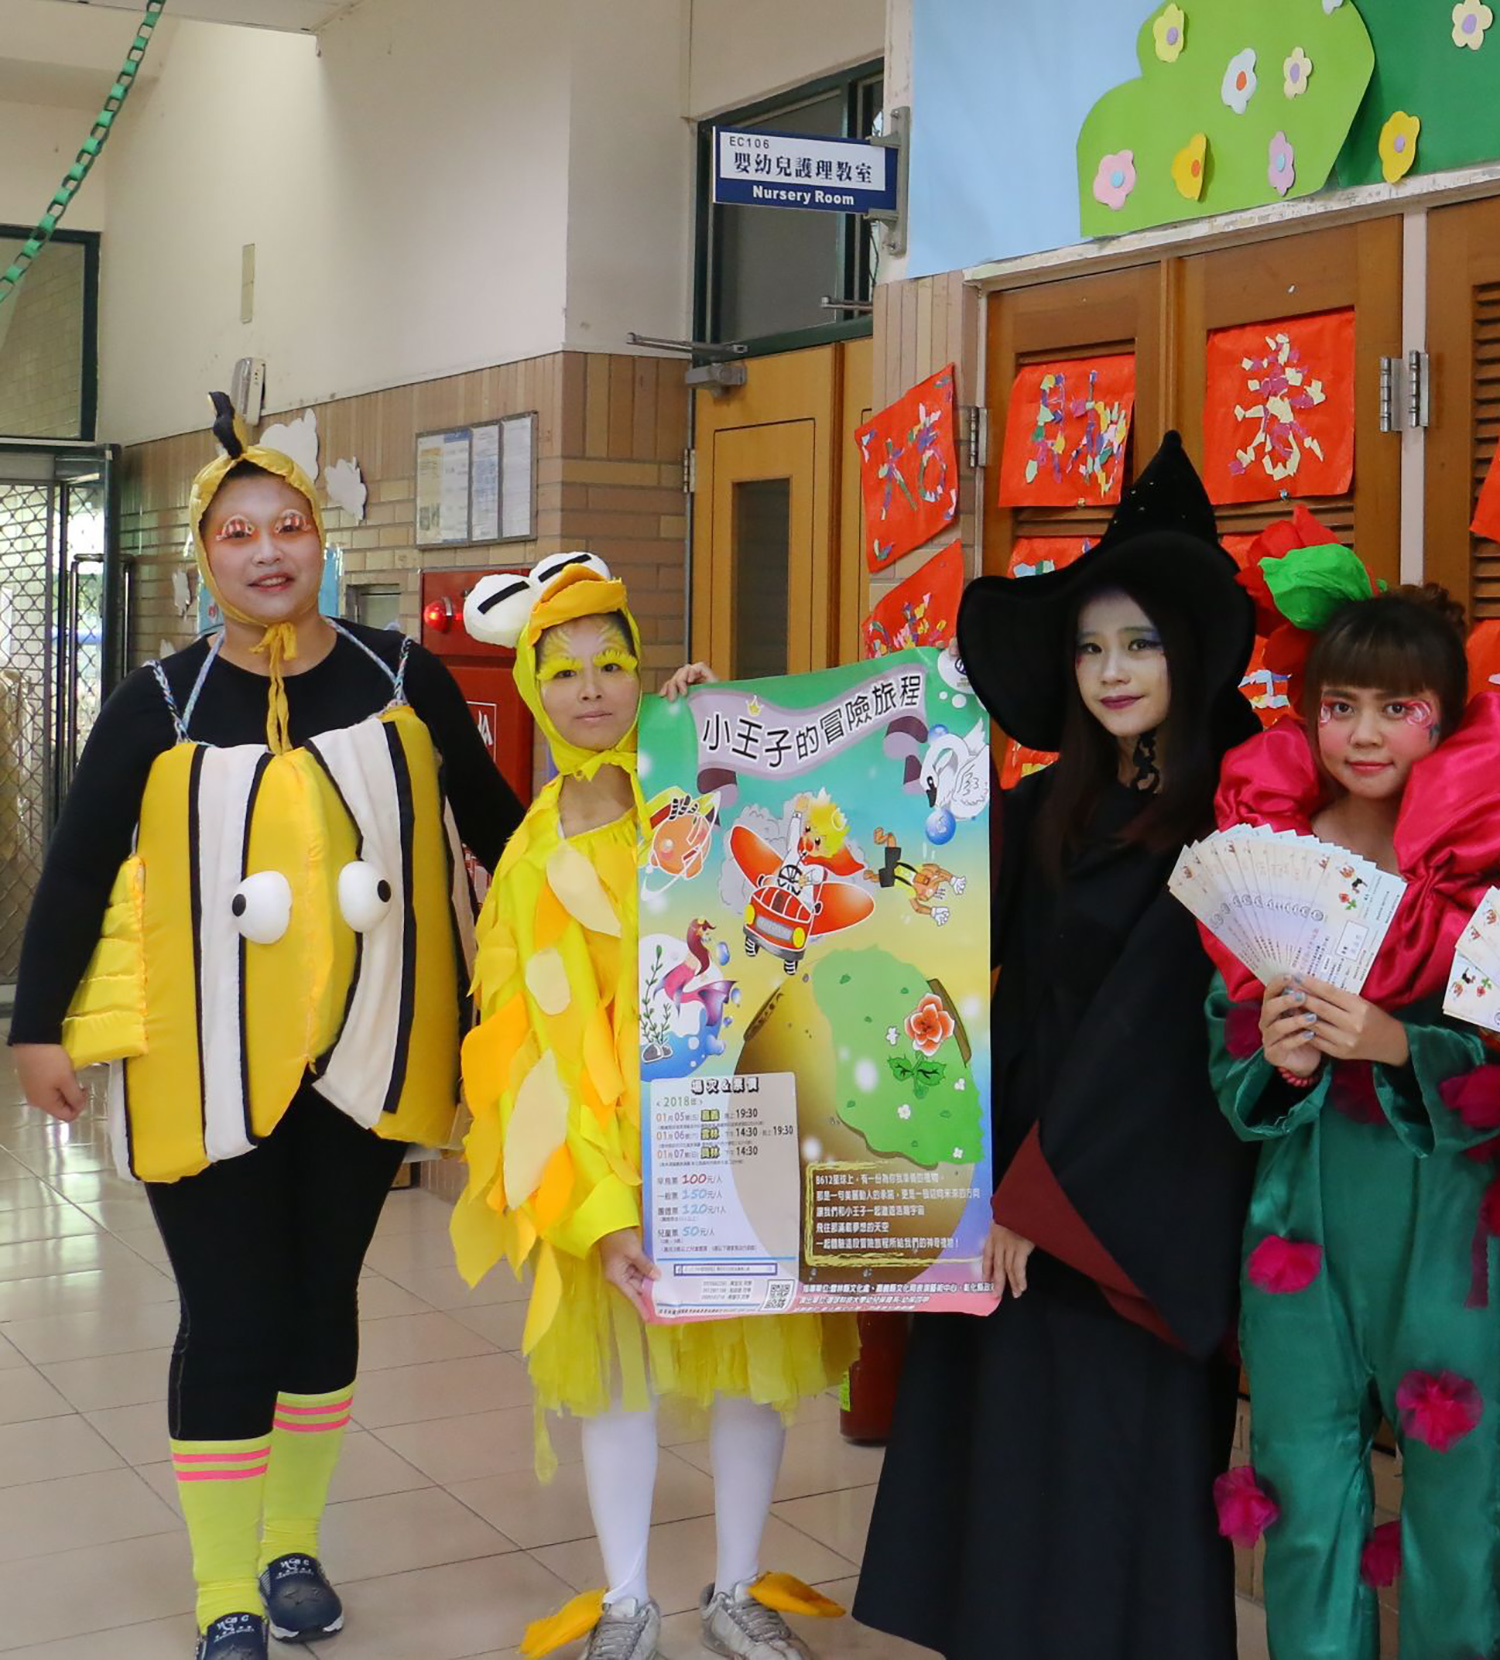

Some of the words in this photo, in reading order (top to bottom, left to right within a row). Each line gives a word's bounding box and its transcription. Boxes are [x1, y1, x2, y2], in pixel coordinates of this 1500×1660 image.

[729, 136, 770, 149] EC106
[734, 152, 872, 184] 嬰幼兒護理教室
[752, 185, 811, 205] Nursery
[814, 190, 855, 205] Room
[702, 675, 921, 768] 小王子的冒險旅程
